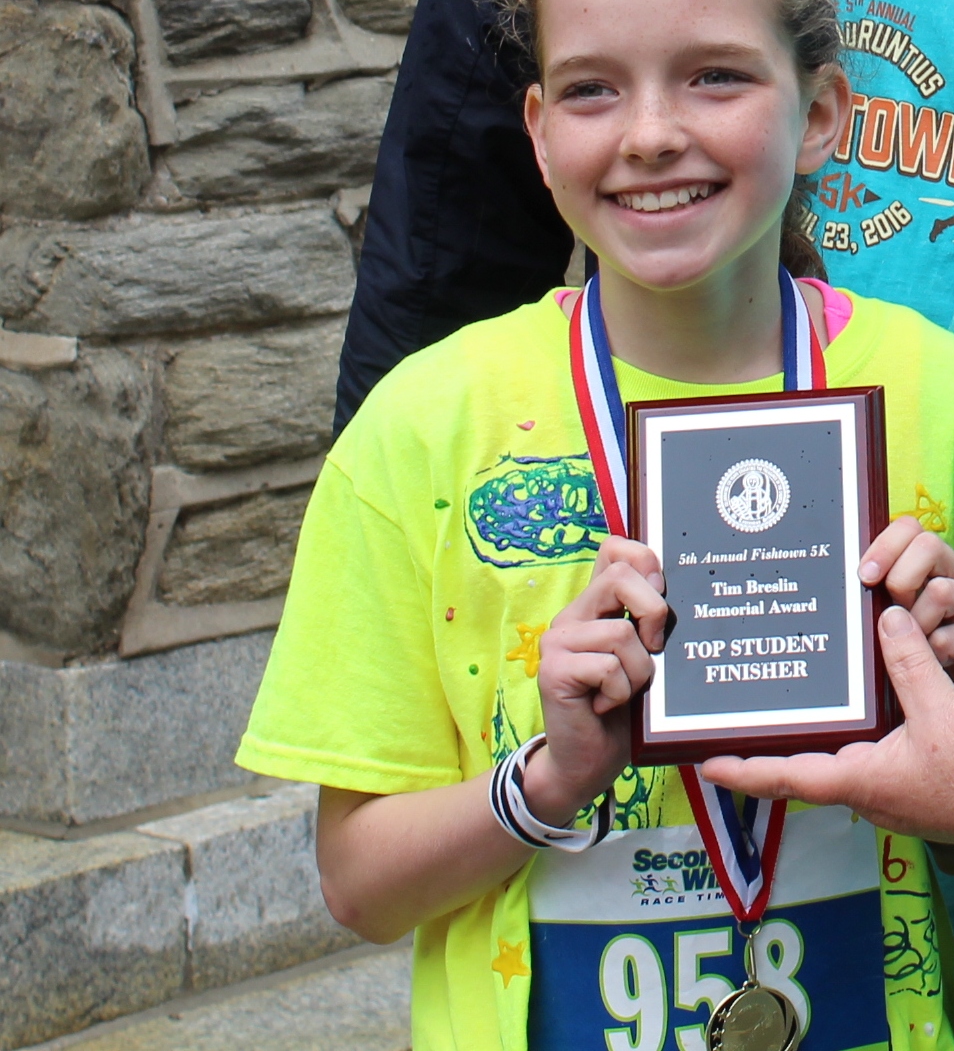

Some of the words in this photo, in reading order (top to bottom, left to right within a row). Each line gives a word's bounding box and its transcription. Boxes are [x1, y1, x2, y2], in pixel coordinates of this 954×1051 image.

[835, 18, 946, 99] URUNTIUS
[818, 172, 866, 213] 5K
[821, 221, 859, 256] 23,
[860, 200, 913, 248] 2016
[678, 552, 697, 565] 5th
[700, 549, 748, 564] Annual
[750, 547, 807, 561] Fishtown
[809, 544, 831, 558] 5K
[711, 581, 742, 597] Tim
[745, 578, 799, 595] Breslin
[693, 600, 765, 619] Memorial
[768, 597, 818, 614] Award
[684, 640, 726, 660] TOP
[730, 633, 829, 657] STUDENT
[705, 660, 809, 683] FINISHER
[632, 848, 713, 872] Seco
[640, 895, 686, 906] RACE
[697, 892, 726, 902] TIM
[598, 918, 812, 1051] 958
